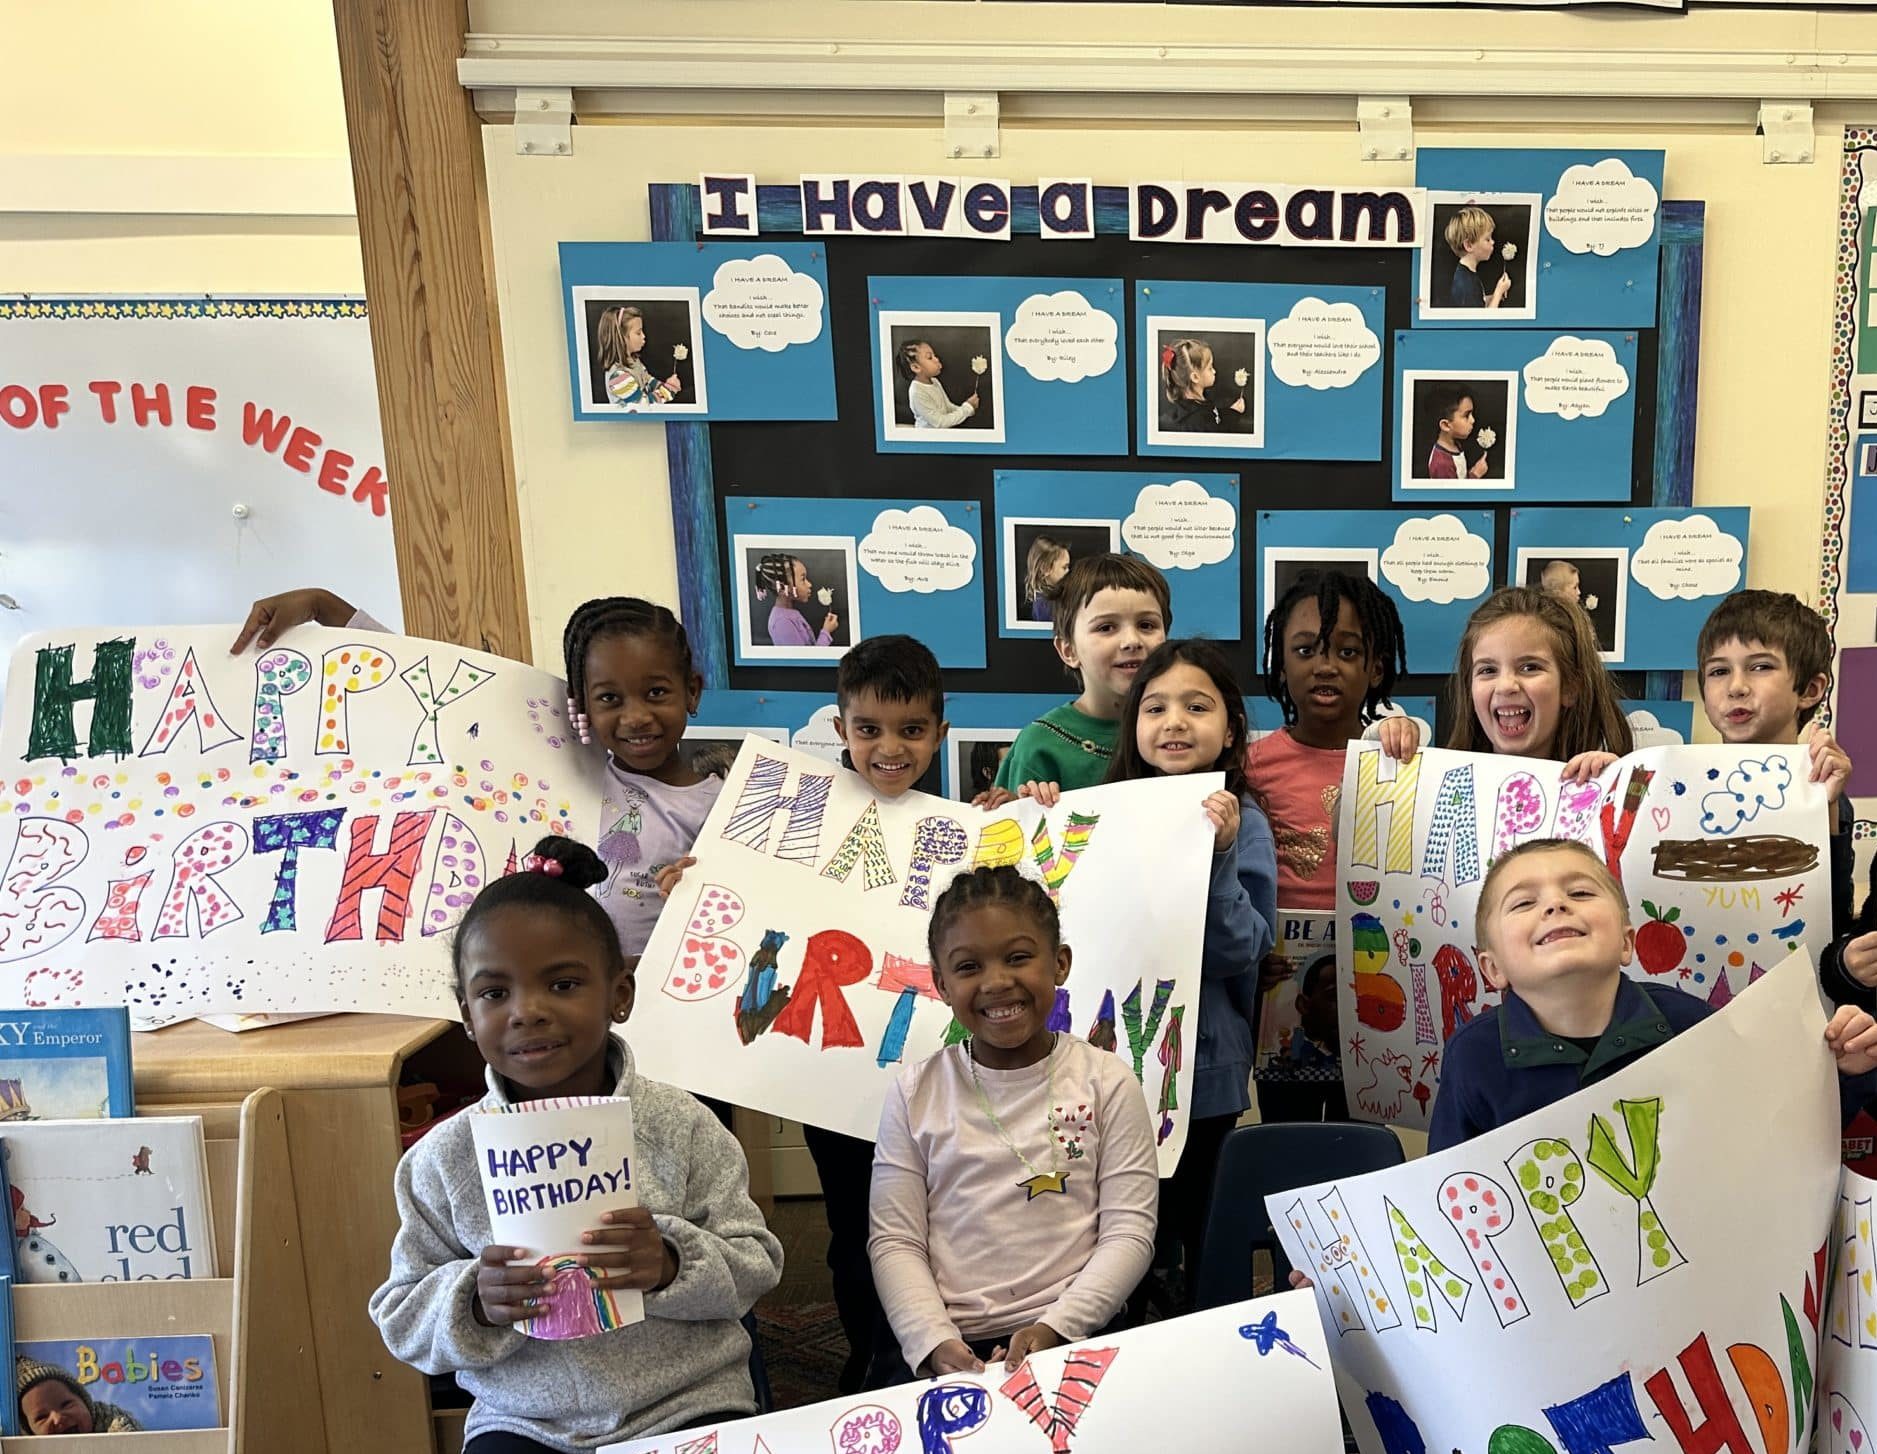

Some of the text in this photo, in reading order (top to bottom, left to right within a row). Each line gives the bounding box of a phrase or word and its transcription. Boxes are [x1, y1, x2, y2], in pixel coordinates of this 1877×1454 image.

[704, 176, 1416, 243] I Have a Dream
[0, 380, 389, 517] OF THE WEEK
[21, 636, 496, 765] HAPPY
[1702, 886, 1761, 911] YUM
[1284, 920, 1316, 940] BE
[33, 1032, 103, 1047] Emperor
[487, 1137, 593, 1178] HAPPY
[493, 1157, 631, 1216] BIRTHDAY!
[105, 1206, 192, 1254] red
[1285, 1096, 1689, 1337] HAPPY
[76, 1344, 204, 1385] Babies
